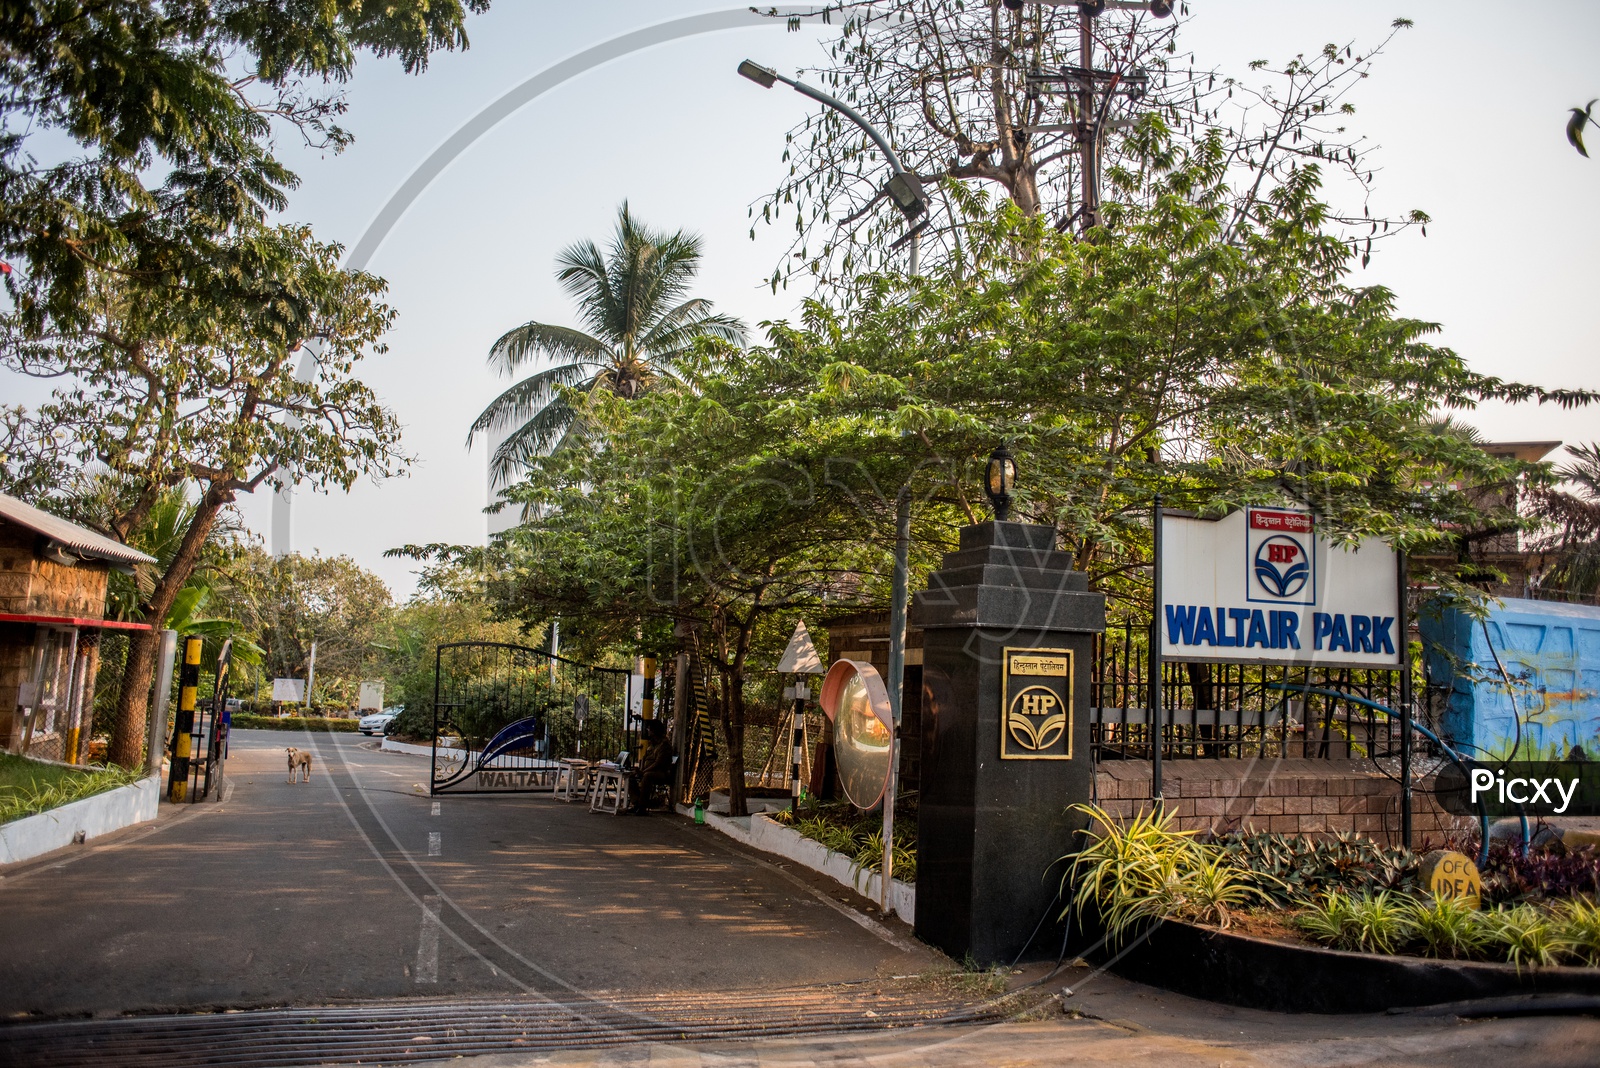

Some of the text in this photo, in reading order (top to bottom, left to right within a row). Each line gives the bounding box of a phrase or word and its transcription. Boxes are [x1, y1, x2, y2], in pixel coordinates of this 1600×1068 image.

[1268, 544, 1298, 563] HP
[1165, 604, 1395, 654] WALTAIR PARK
[1013, 659, 1038, 673] हिन्दुस्तान
[1021, 694, 1056, 715] HP
[1442, 860, 1471, 876] OFC
[1436, 878, 1479, 900] IDEA
